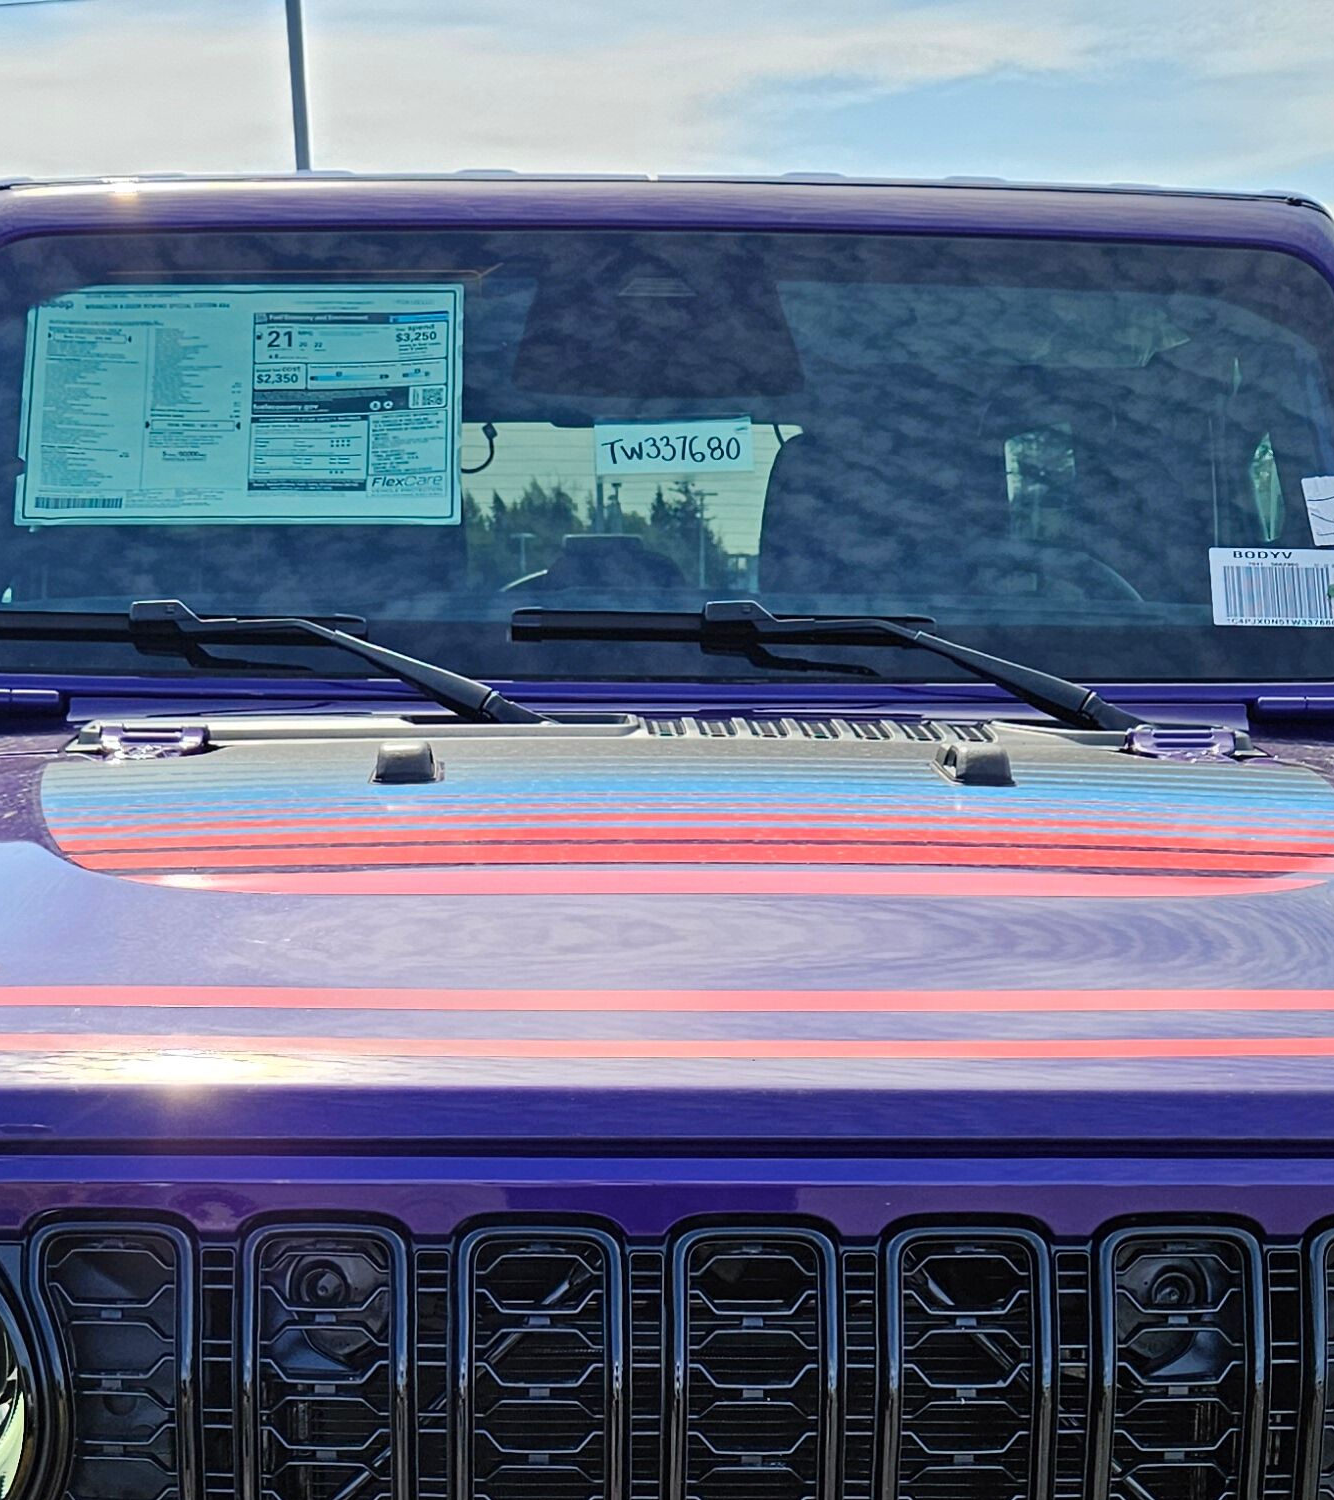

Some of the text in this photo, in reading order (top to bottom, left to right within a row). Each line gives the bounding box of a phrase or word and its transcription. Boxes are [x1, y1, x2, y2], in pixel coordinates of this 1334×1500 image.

[267, 330, 293, 348] 21
[395, 331, 437, 343] $3,250
[256, 373, 299, 384] $2,350
[601, 436, 741, 464] TW337680
[371, 475, 443, 487] FlexCare
[1233, 550, 1293, 559] BODYV
